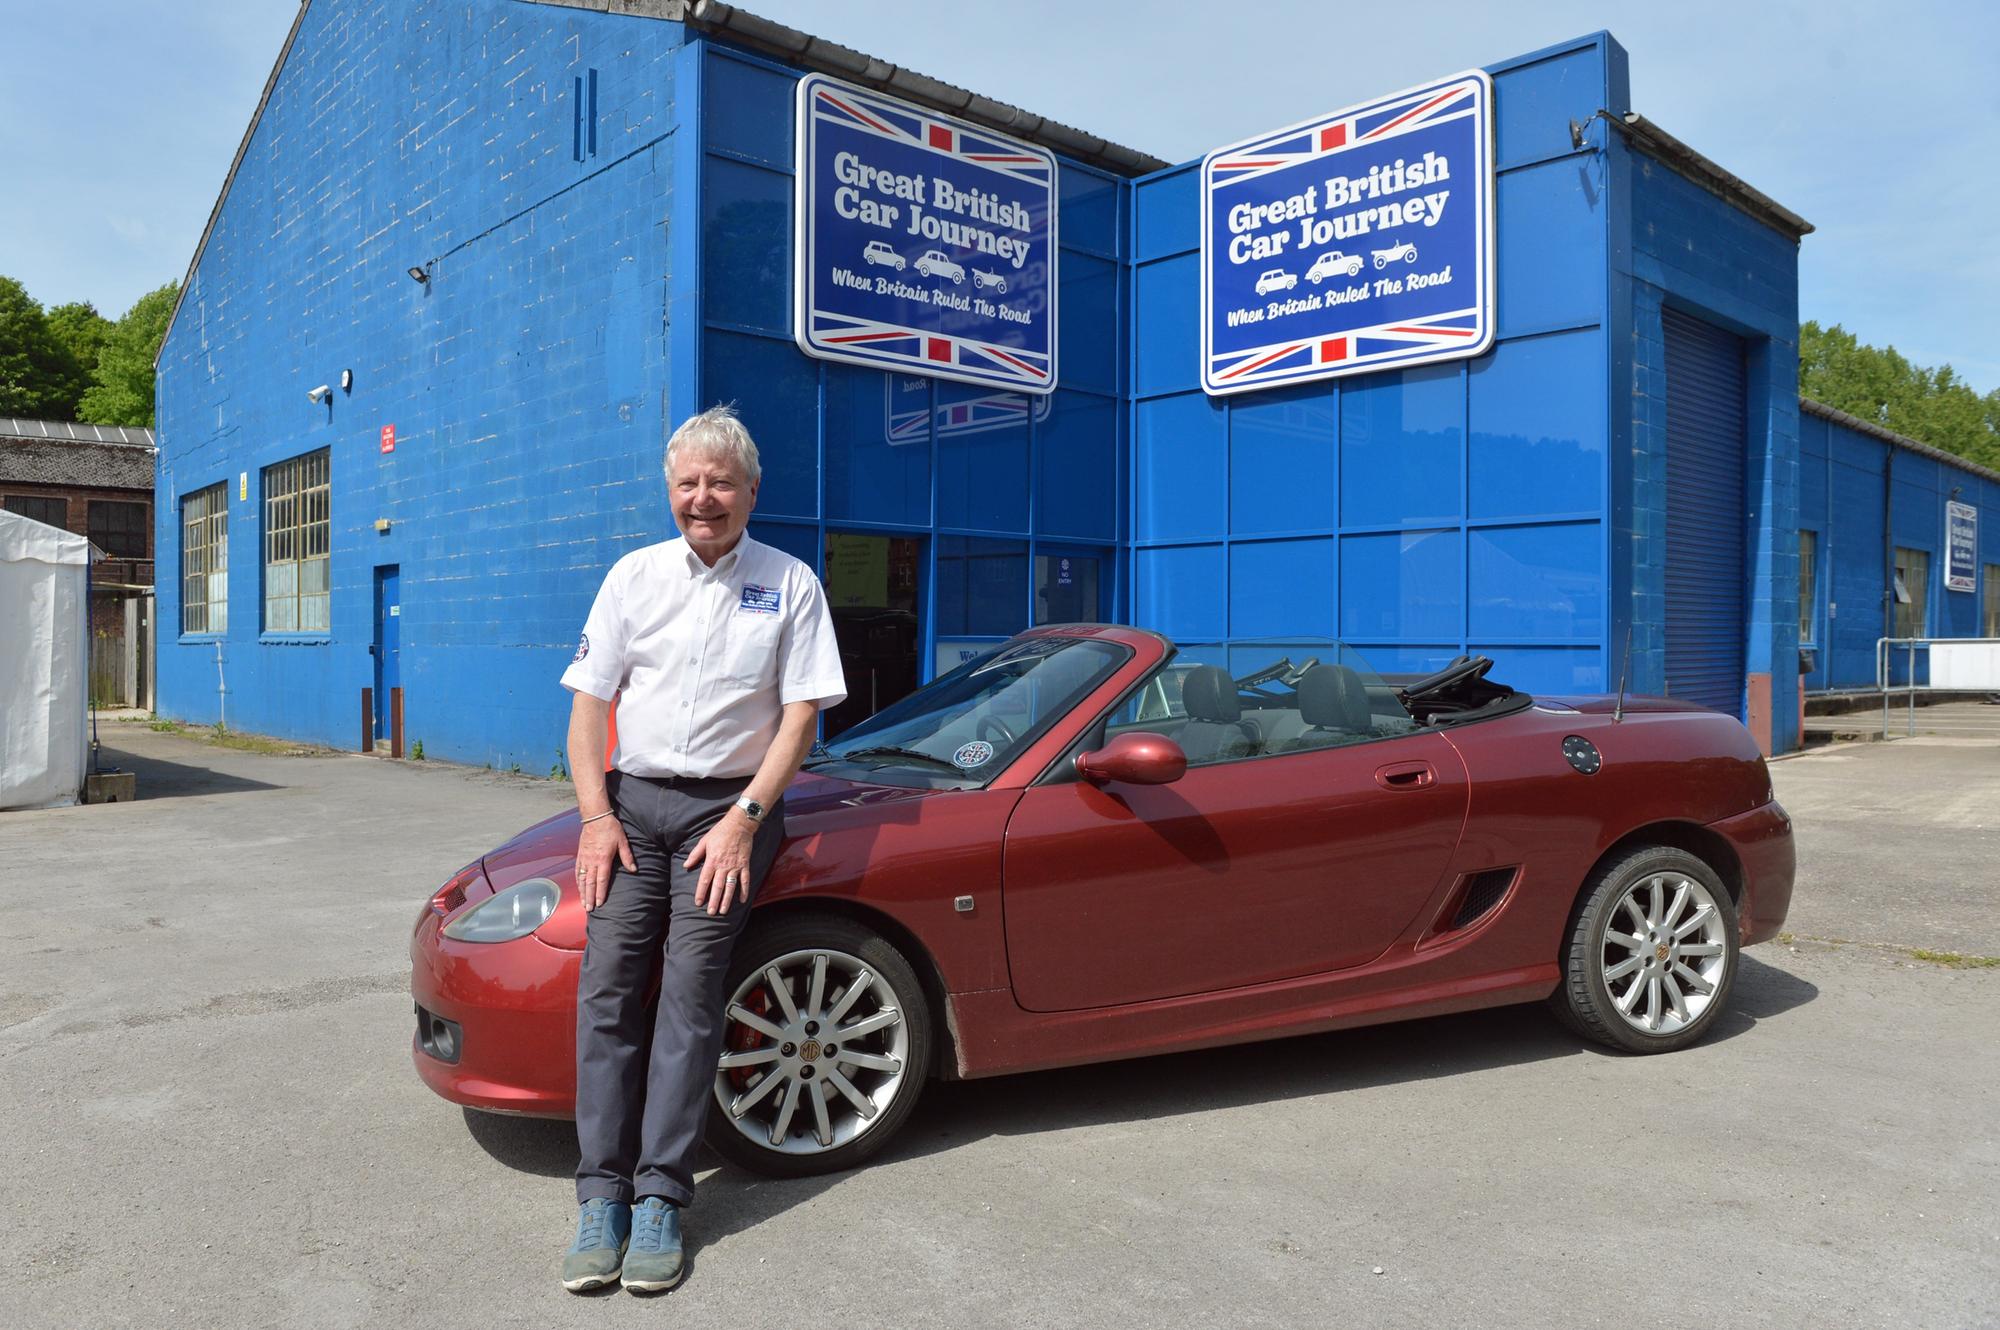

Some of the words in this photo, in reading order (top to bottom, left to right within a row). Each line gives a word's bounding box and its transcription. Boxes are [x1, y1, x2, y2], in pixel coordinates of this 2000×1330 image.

[834, 152, 926, 204] Great
[933, 177, 1031, 232] British
[834, 187, 899, 229] Car
[907, 204, 1031, 269] Journey
[1228, 186, 1318, 234] Great
[1325, 151, 1450, 210] British
[1228, 232, 1290, 265] Car
[1298, 190, 1450, 249] Journey
[832, 267, 873, 291] When
[875, 277, 929, 303] Britain
[932, 289, 971, 311] Ruled
[973, 298, 997, 318] The
[998, 303, 1032, 325] Road
[1227, 308, 1265, 327] When
[1267, 294, 1322, 321] Britain
[1325, 284, 1370, 307] Ruled
[1374, 276, 1403, 298] The
[1406, 266, 1452, 291] Road
[802, 1043, 818, 1059] MG
